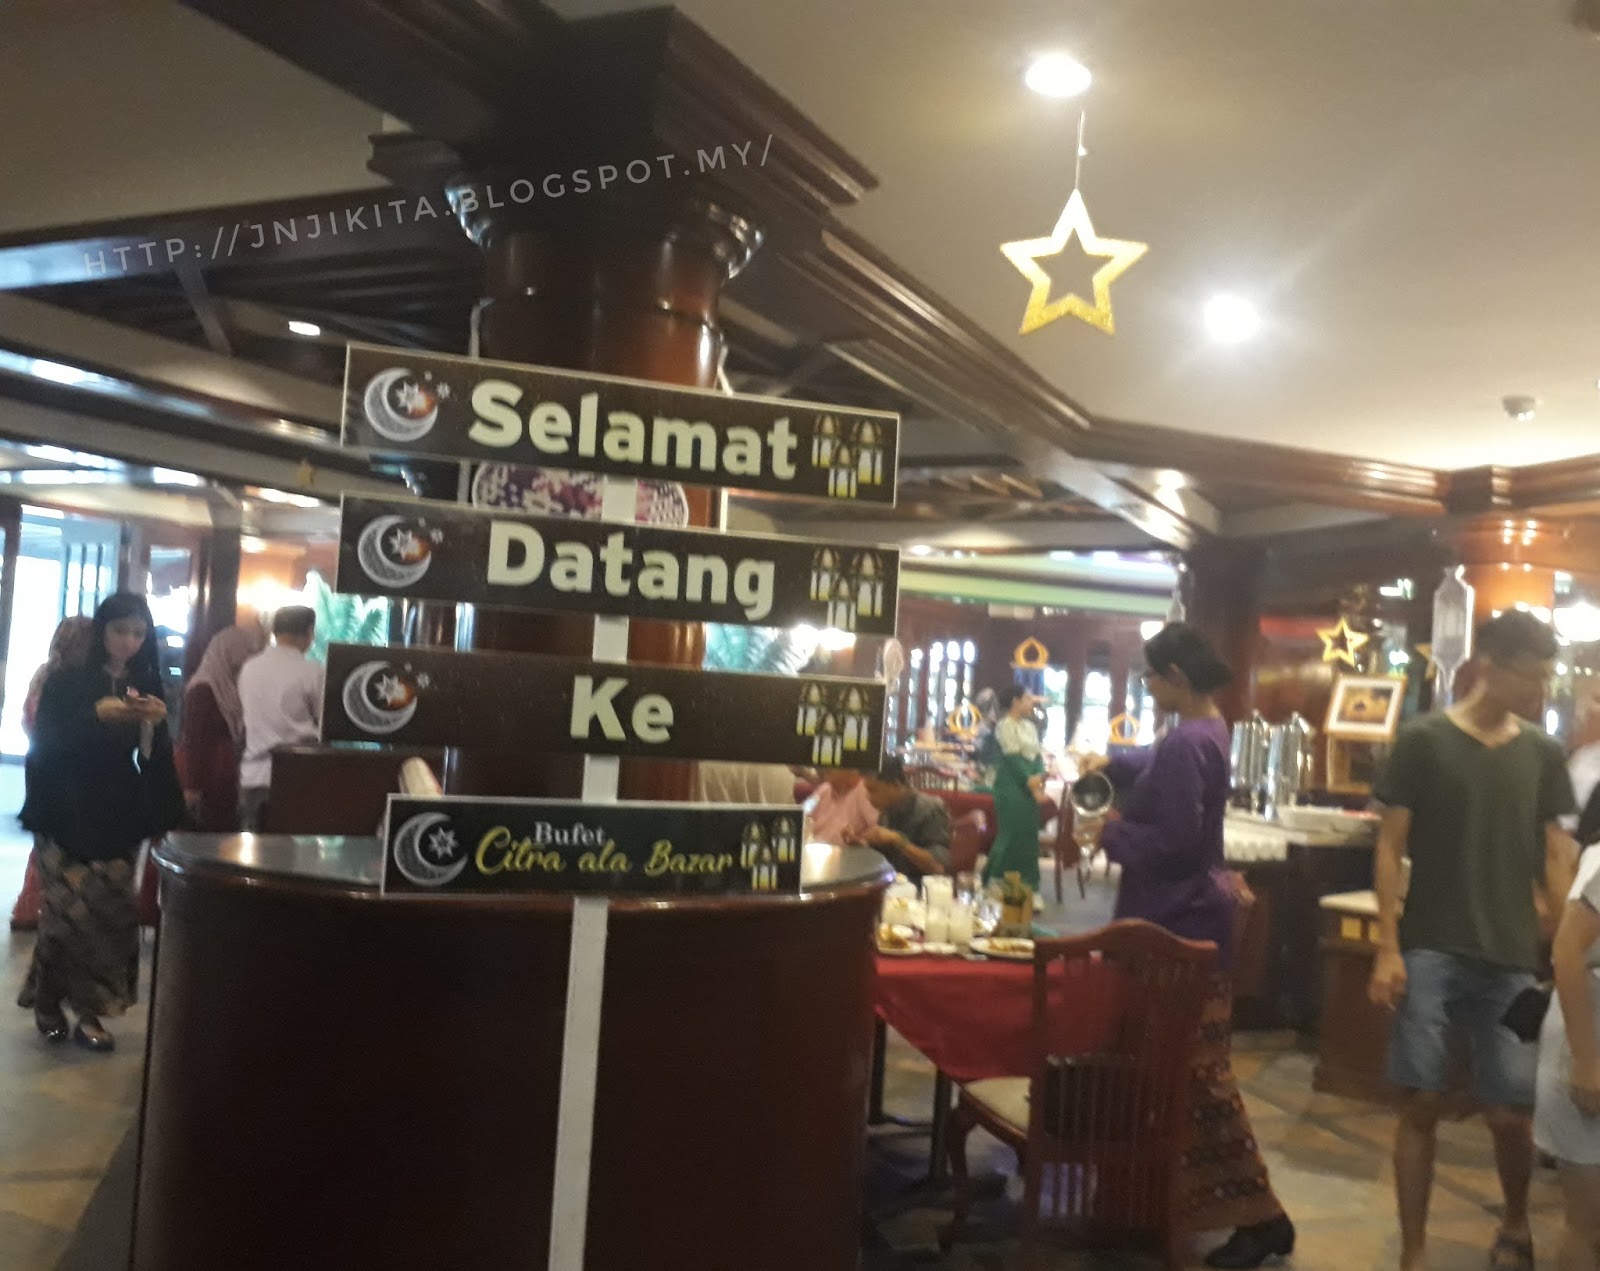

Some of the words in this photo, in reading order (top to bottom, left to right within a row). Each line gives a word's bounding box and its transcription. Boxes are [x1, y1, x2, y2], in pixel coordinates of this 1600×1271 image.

[468, 379, 798, 480] Selamat
[487, 520, 775, 621] Datang
[570, 675, 674, 742] Ke
[475, 825, 566, 876] Citra
[577, 838, 633, 873] ala
[644, 838, 733, 877] Bazar
[534, 821, 605, 846] Bufet
